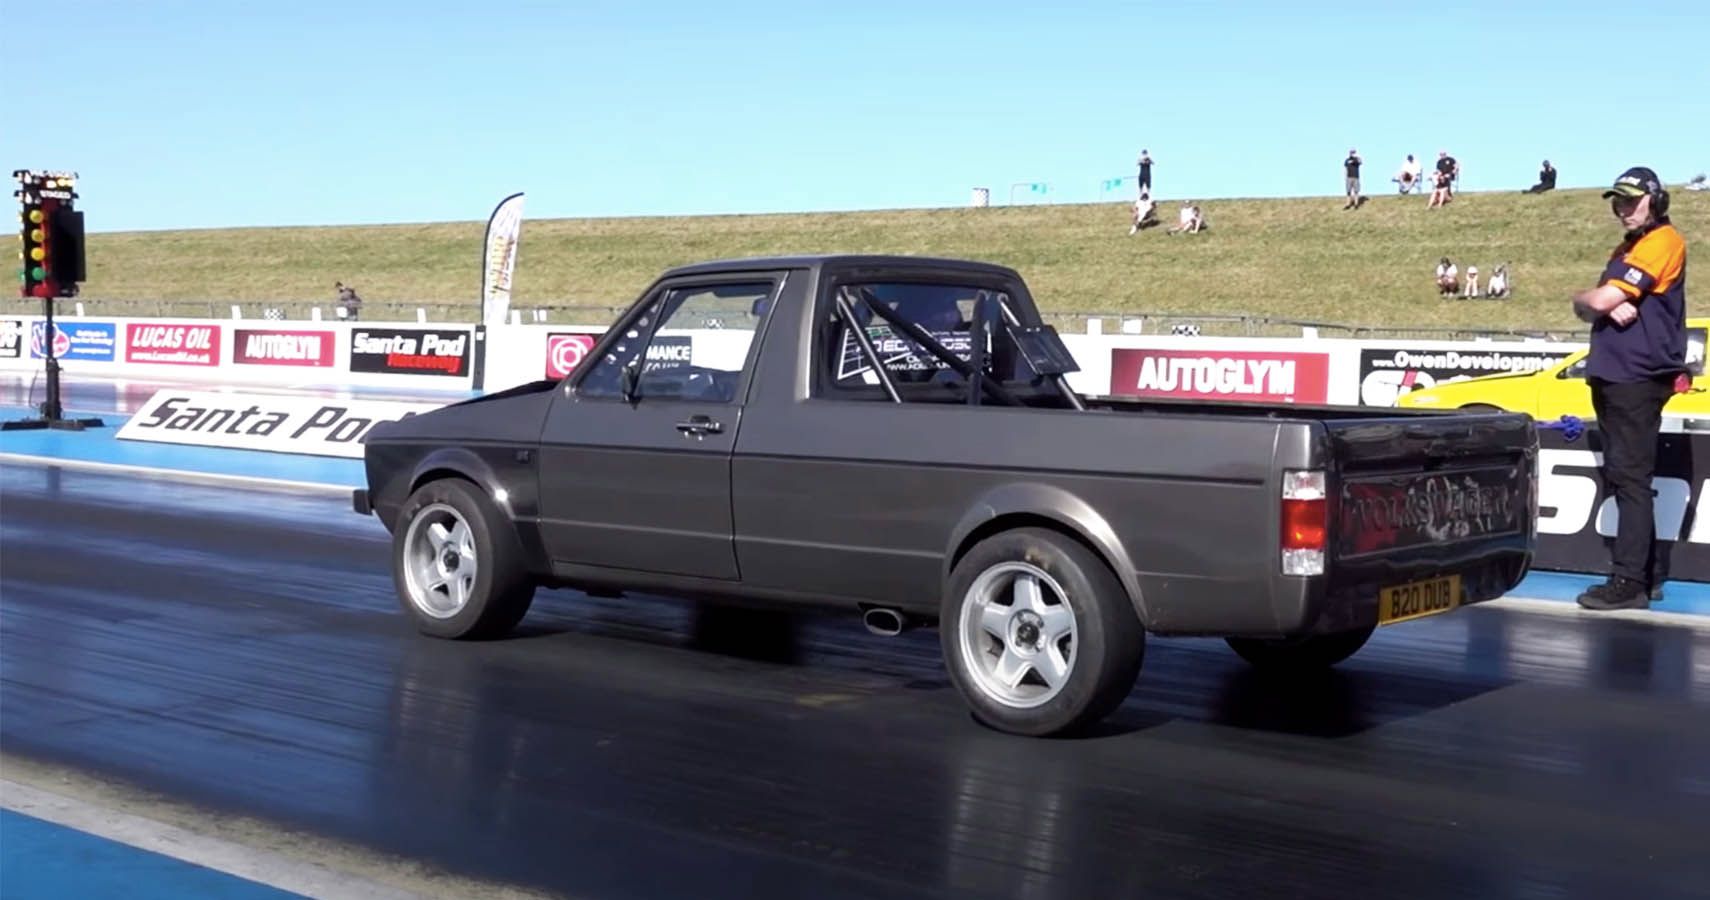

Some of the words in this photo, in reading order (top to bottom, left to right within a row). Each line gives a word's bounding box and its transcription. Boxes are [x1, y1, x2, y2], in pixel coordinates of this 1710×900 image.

[131, 327, 184, 348] LUCAS
[185, 328, 211, 349] OIL
[245, 334, 321, 360] AUTOGLYM
[353, 332, 417, 355] Santa
[420, 334, 466, 357] Pod
[1137, 357, 1296, 395] AUTOGLYM
[138, 397, 290, 437] Santa
[289, 405, 373, 444] Po
[1391, 585, 1420, 618] B20
[1424, 580, 1450, 610] DUB
